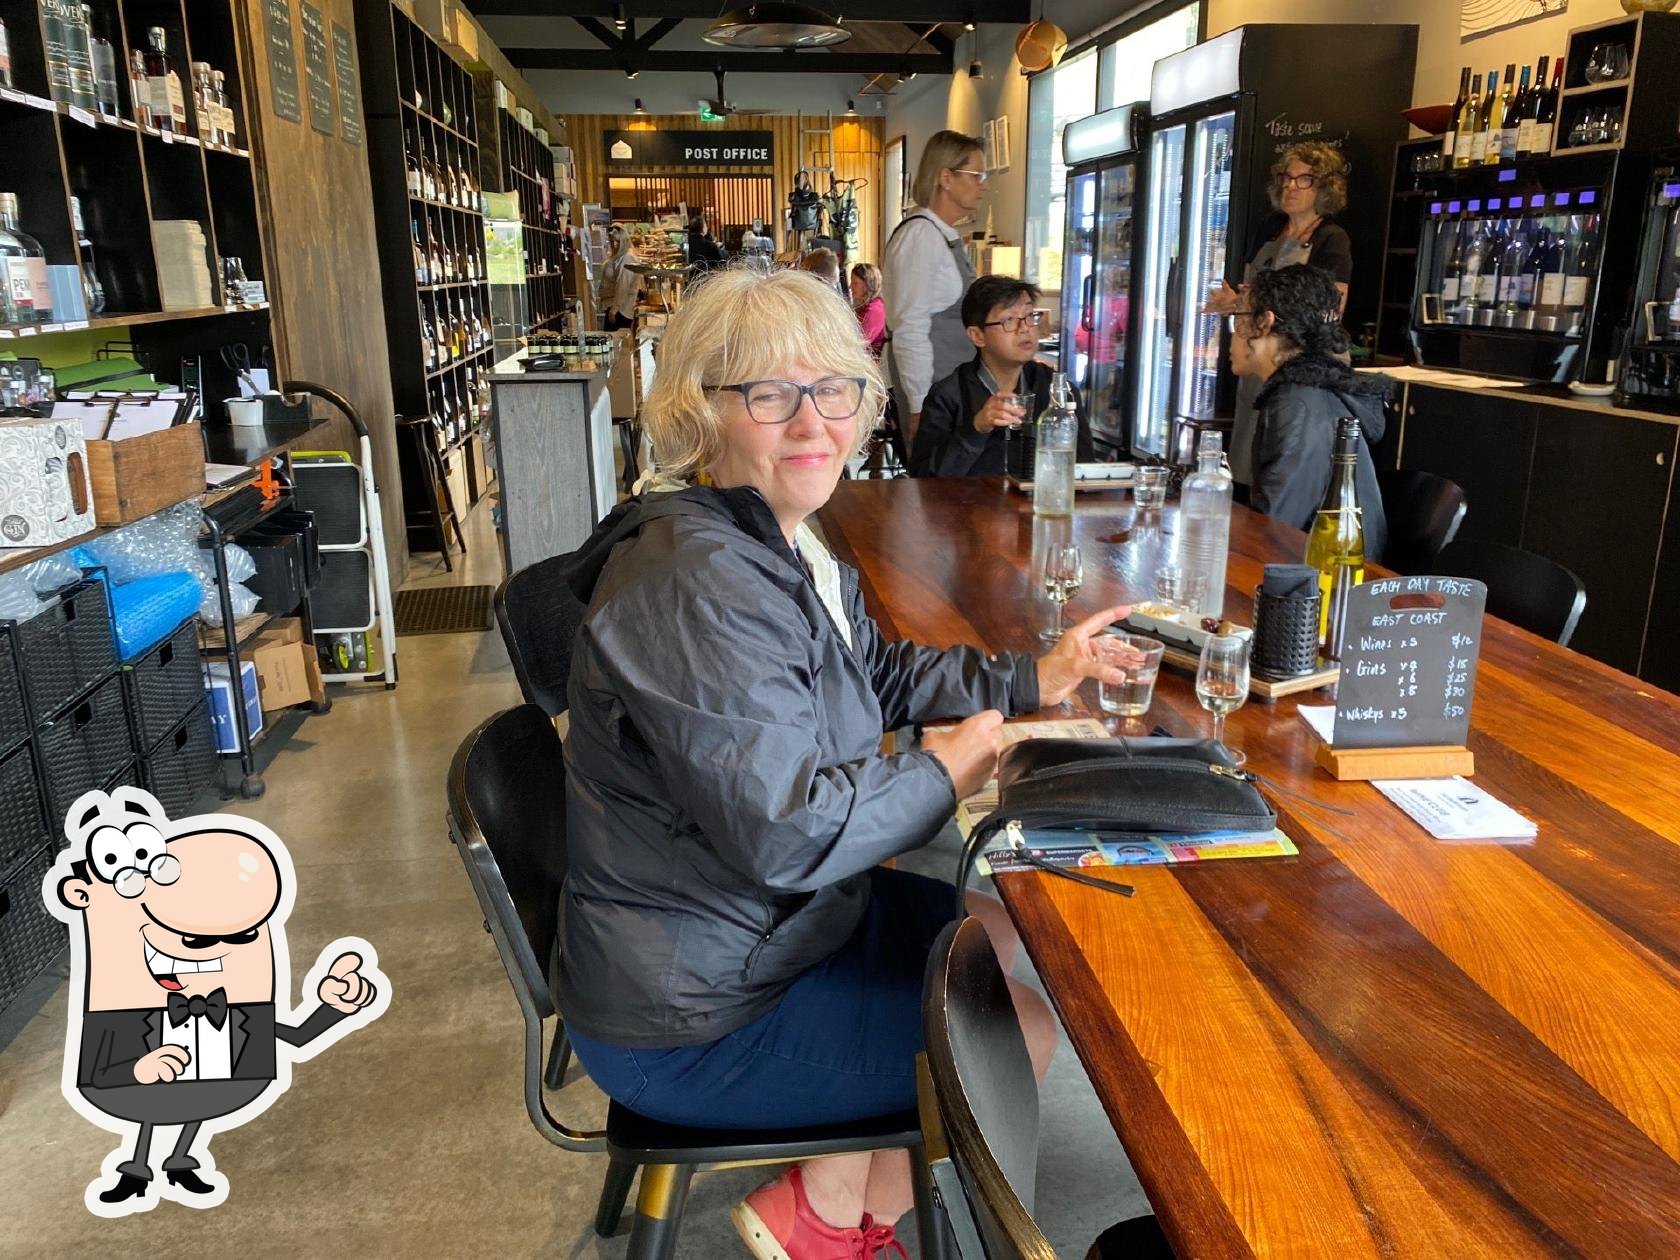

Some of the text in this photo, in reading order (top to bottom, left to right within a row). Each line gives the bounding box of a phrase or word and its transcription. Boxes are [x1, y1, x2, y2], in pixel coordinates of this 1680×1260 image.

[1265, 112, 1294, 137] Taste
[685, 148, 768, 160] POST OFFICE
[1371, 578, 1473, 597] EACH DAY TASTE
[1372, 612, 1448, 626] EAST COAST
[1361, 635, 1392, 650] Wines
[1357, 660, 1387, 677] Gins
